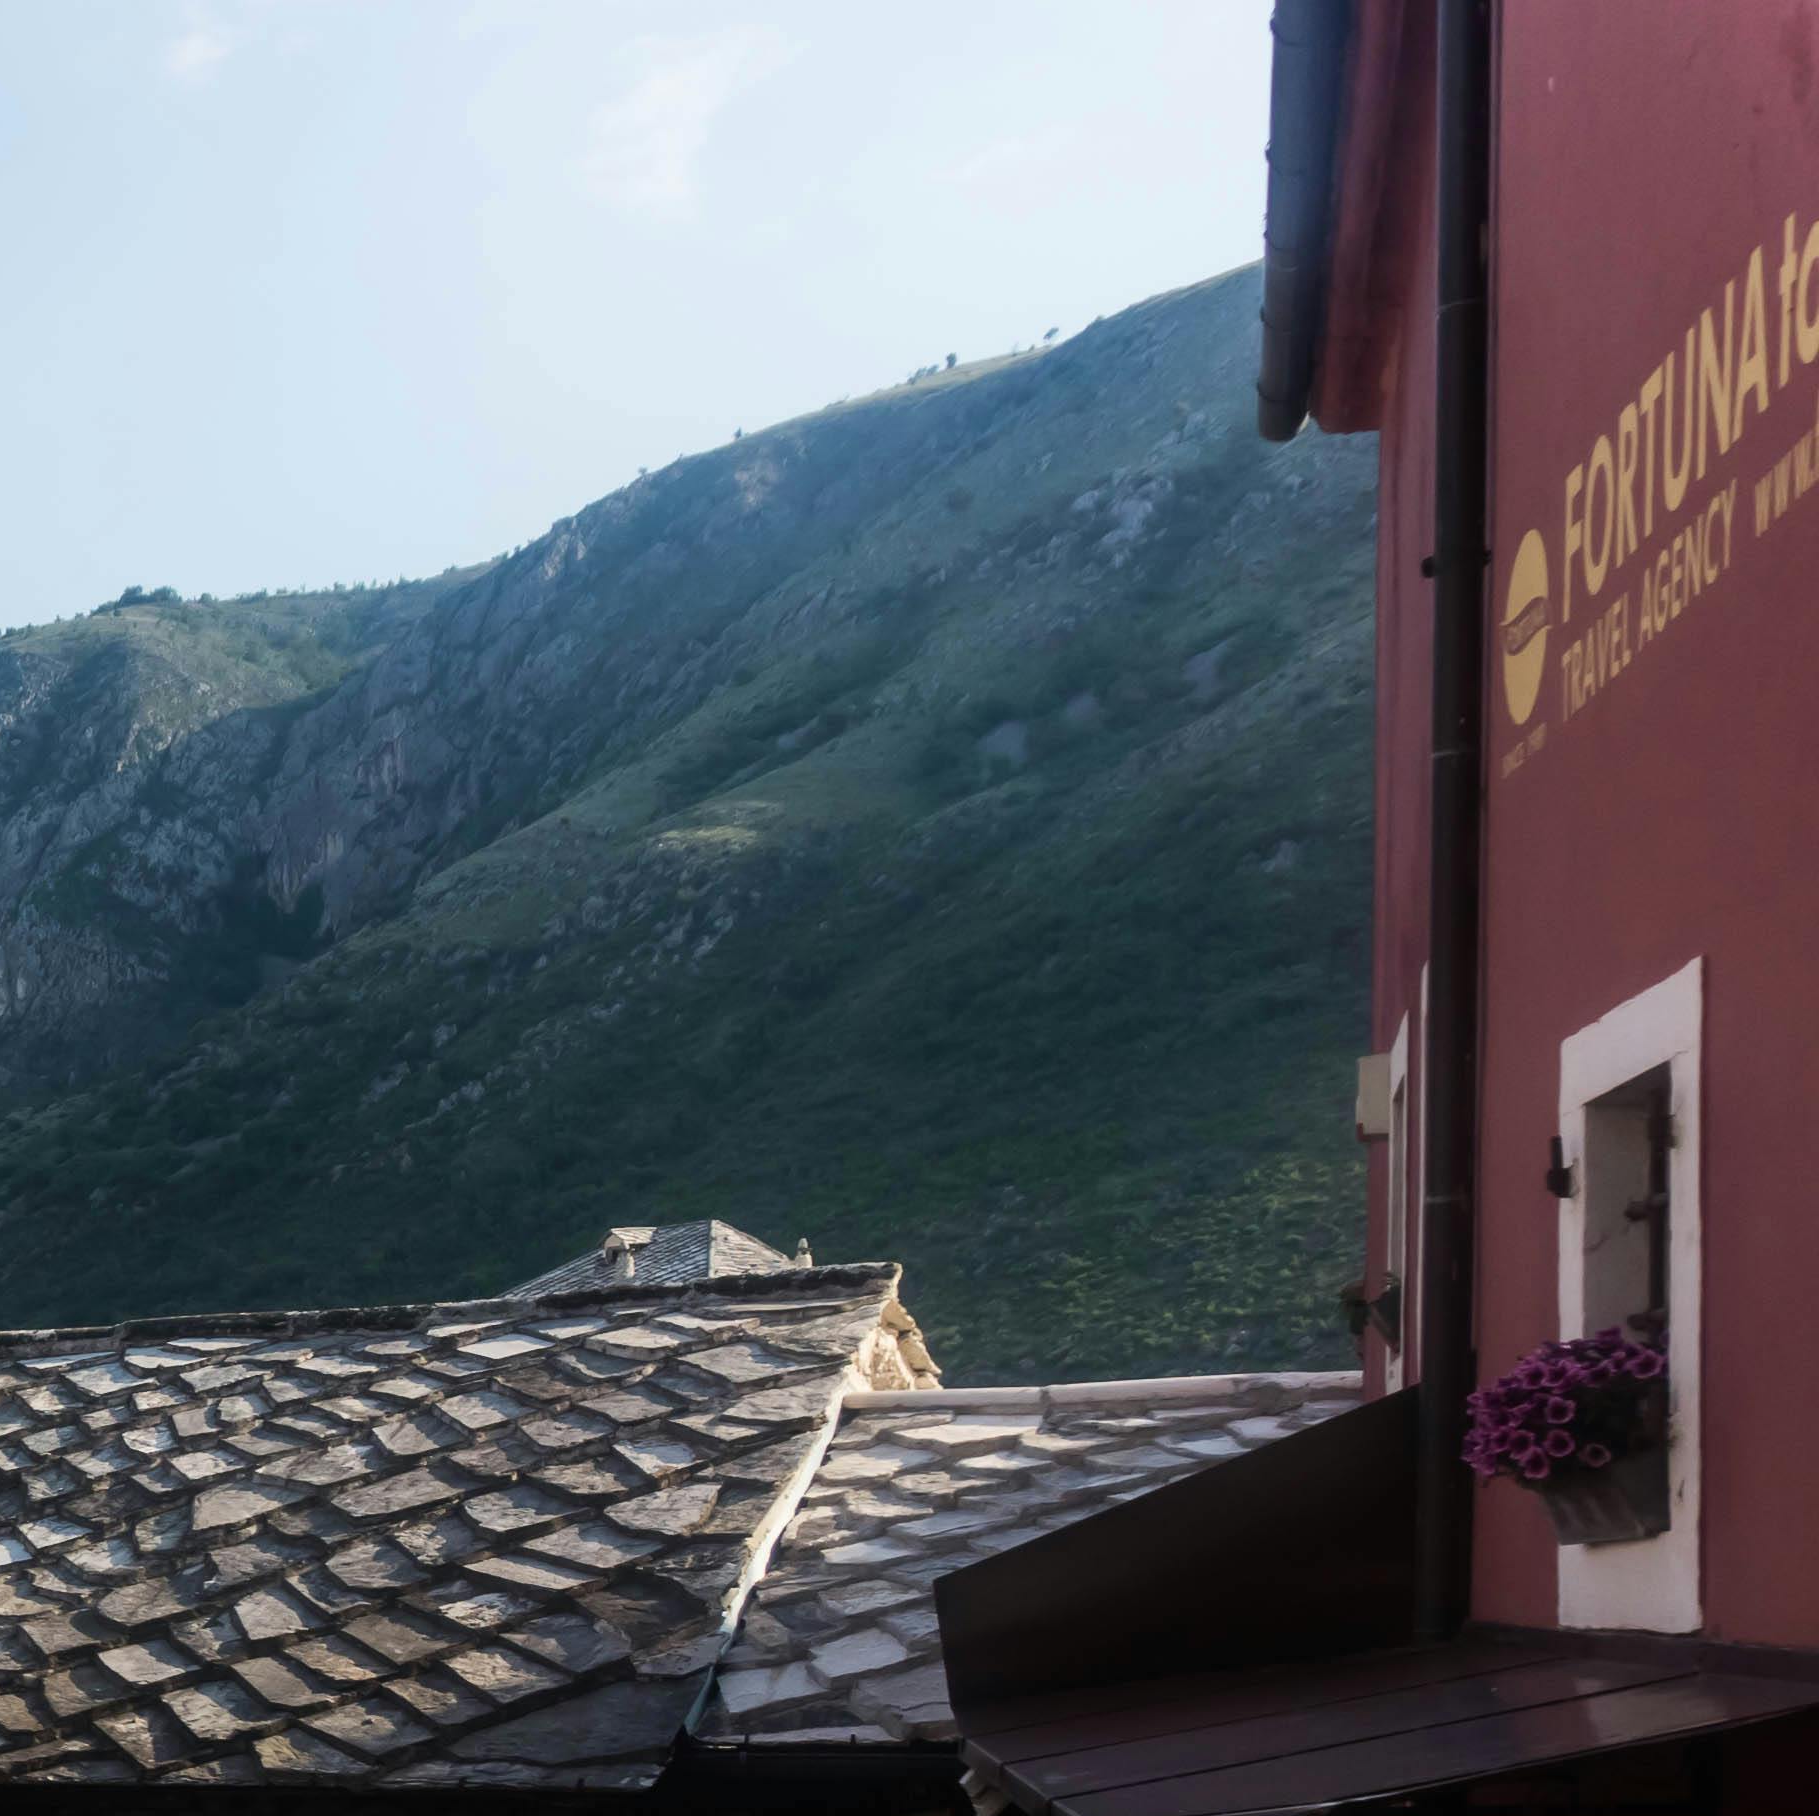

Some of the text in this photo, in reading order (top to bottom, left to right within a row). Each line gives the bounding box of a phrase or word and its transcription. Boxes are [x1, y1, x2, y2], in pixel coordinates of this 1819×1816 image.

[1563, 212, 1819, 624] FORTUNA to
[1561, 592, 1632, 723] TRAVEL
[1638, 478, 1737, 651] AGENCY
